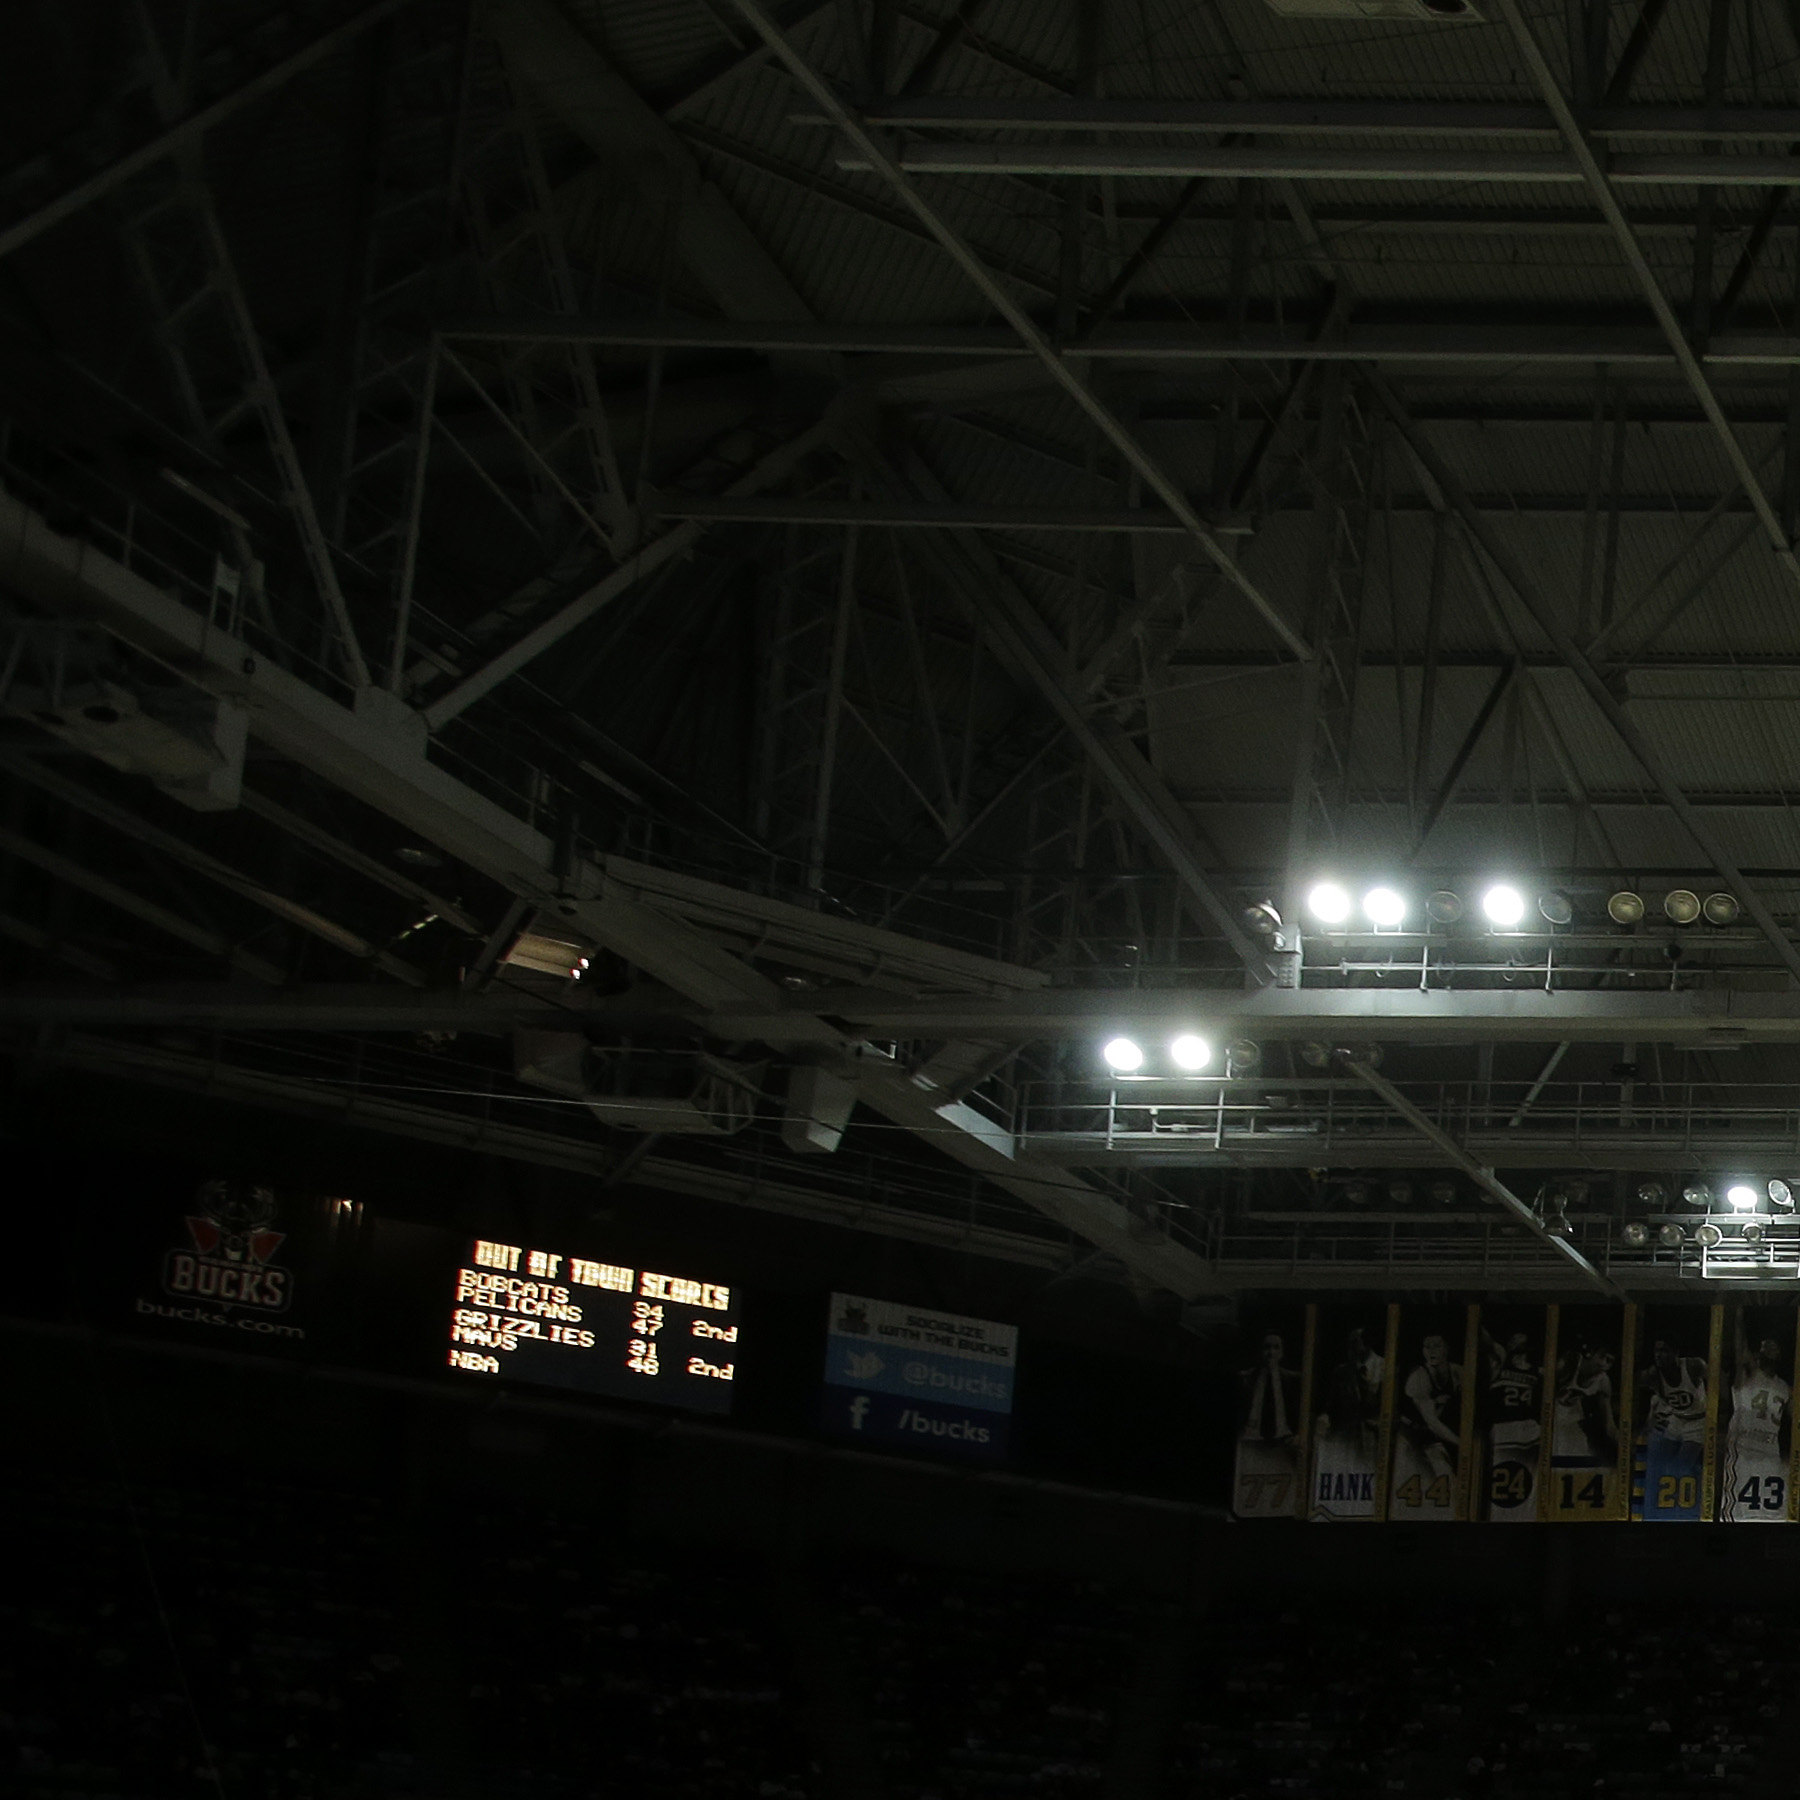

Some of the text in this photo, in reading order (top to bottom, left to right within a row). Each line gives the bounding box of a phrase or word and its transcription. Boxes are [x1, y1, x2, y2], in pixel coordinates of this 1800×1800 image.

[458, 1268, 570, 1304] BOBCATS
[474, 1240, 730, 1311] OUT OF TOWN SCORES
[134, 1298, 306, 1340] bucks.com
[453, 1308, 596, 1349] GRIZZLIES
[456, 1285, 738, 1343] PELICANS 2nd
[451, 1324, 519, 1351] MAVS
[449, 1349, 500, 1374] NBA
[903, 1362, 1007, 1399] @bucks
[897, 1409, 991, 1444] /bucks
[1320, 1473, 1375, 1501] HANK
[1560, 1474, 1605, 1509] 14
[1658, 1476, 1697, 1509] 20
[1738, 1476, 1785, 1510] 43
